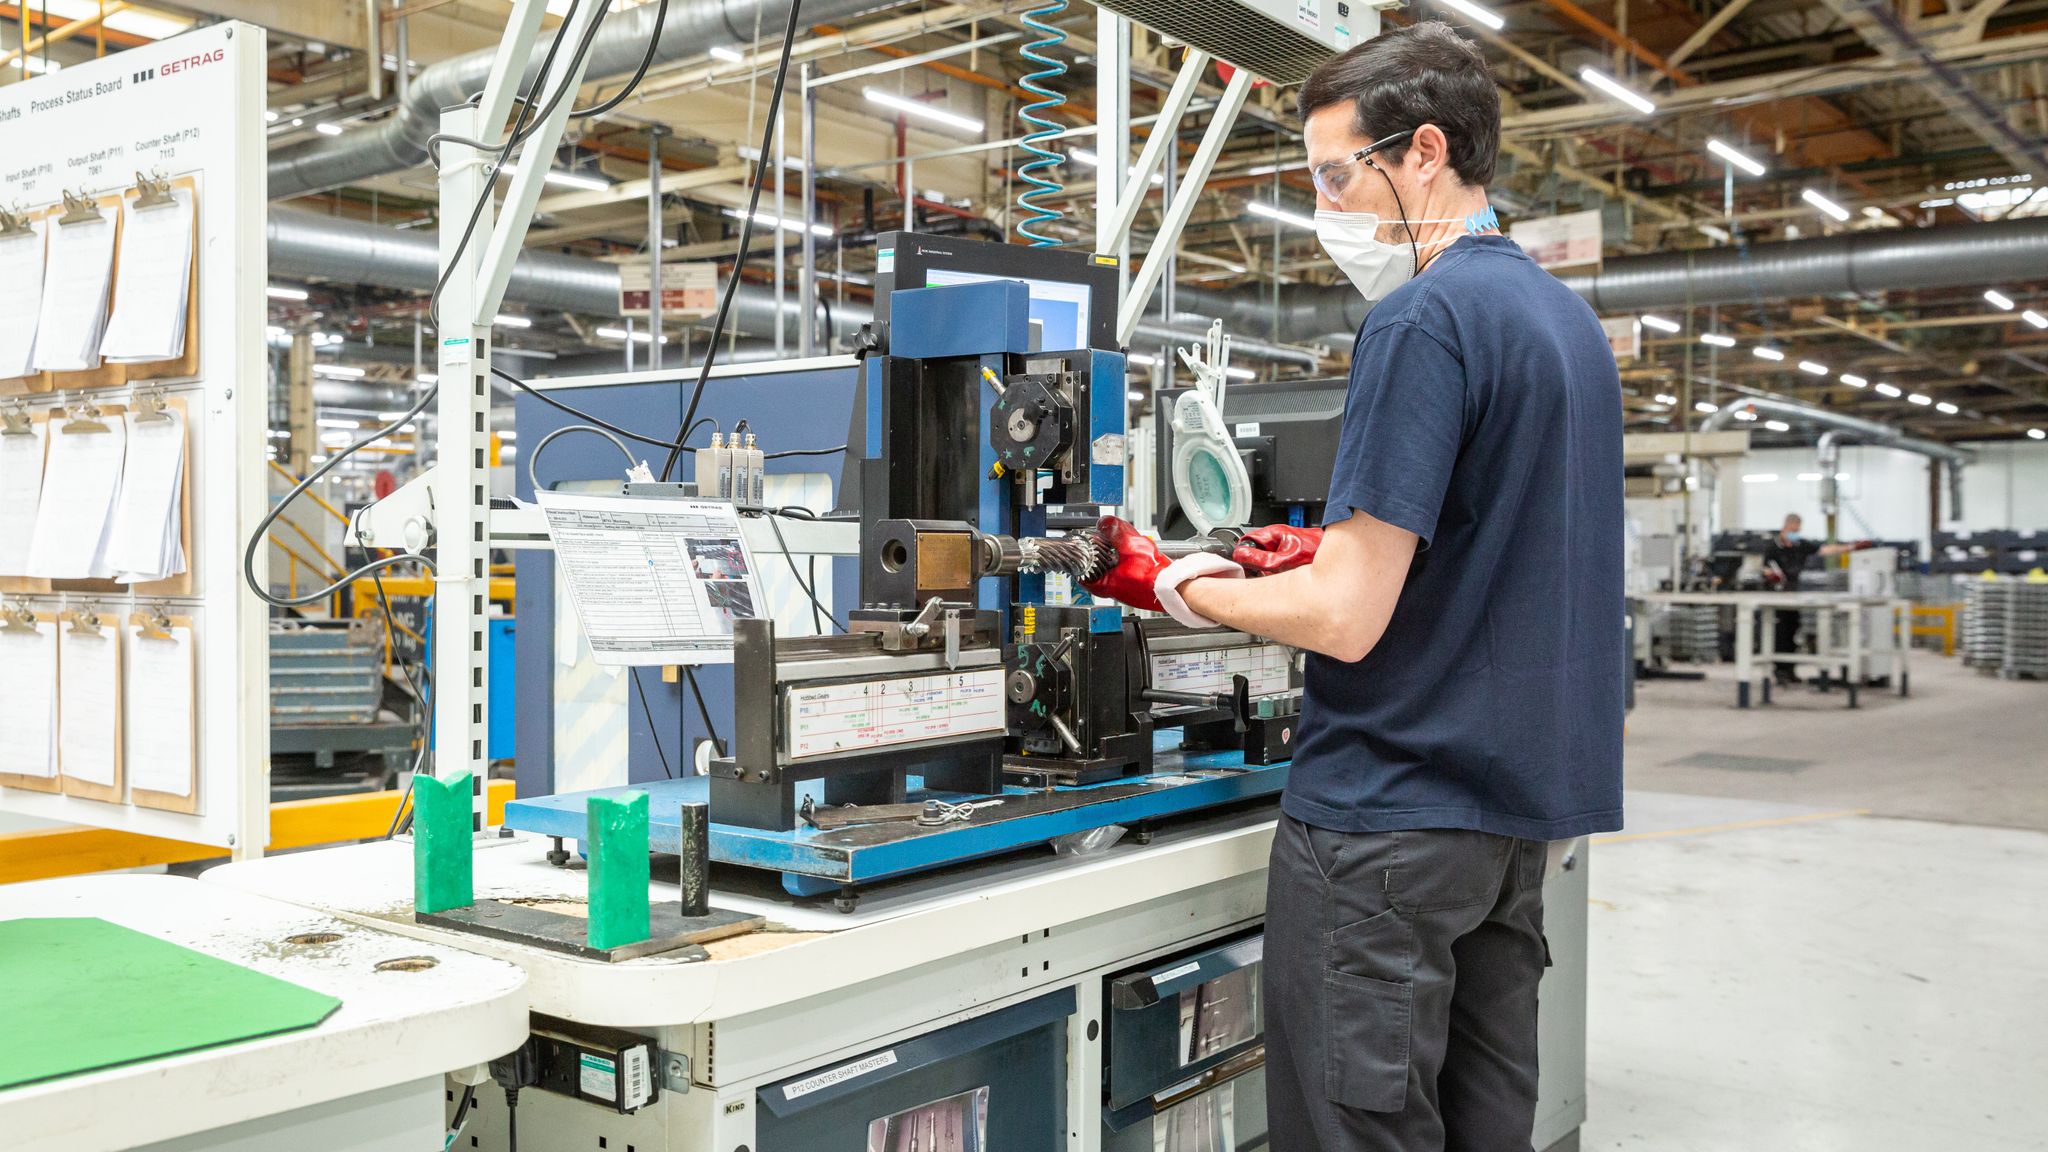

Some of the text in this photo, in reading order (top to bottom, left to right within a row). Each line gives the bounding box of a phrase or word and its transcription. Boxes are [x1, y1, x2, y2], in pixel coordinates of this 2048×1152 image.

[160, 48, 225, 76] GETRAG
[31, 95, 64, 113] Process
[66, 87, 94, 104] Status
[95, 76, 123, 96] Board
[135, 127, 200, 152] Counter Shaft (P12)
[67, 155, 89, 168] Output
[90, 149, 106, 162] Shaft
[159, 147, 175, 160] 7113
[21, 167, 36, 180] Shaft
[1017, 644, 1029, 669] 5
[863, 685, 869, 696] 4
[880, 683, 886, 695] 2
[908, 680, 914, 692] 3
[958, 675, 964, 687] 5
[792, 1055, 889, 1095] P12 COUNTER SHAFT MASTERS
